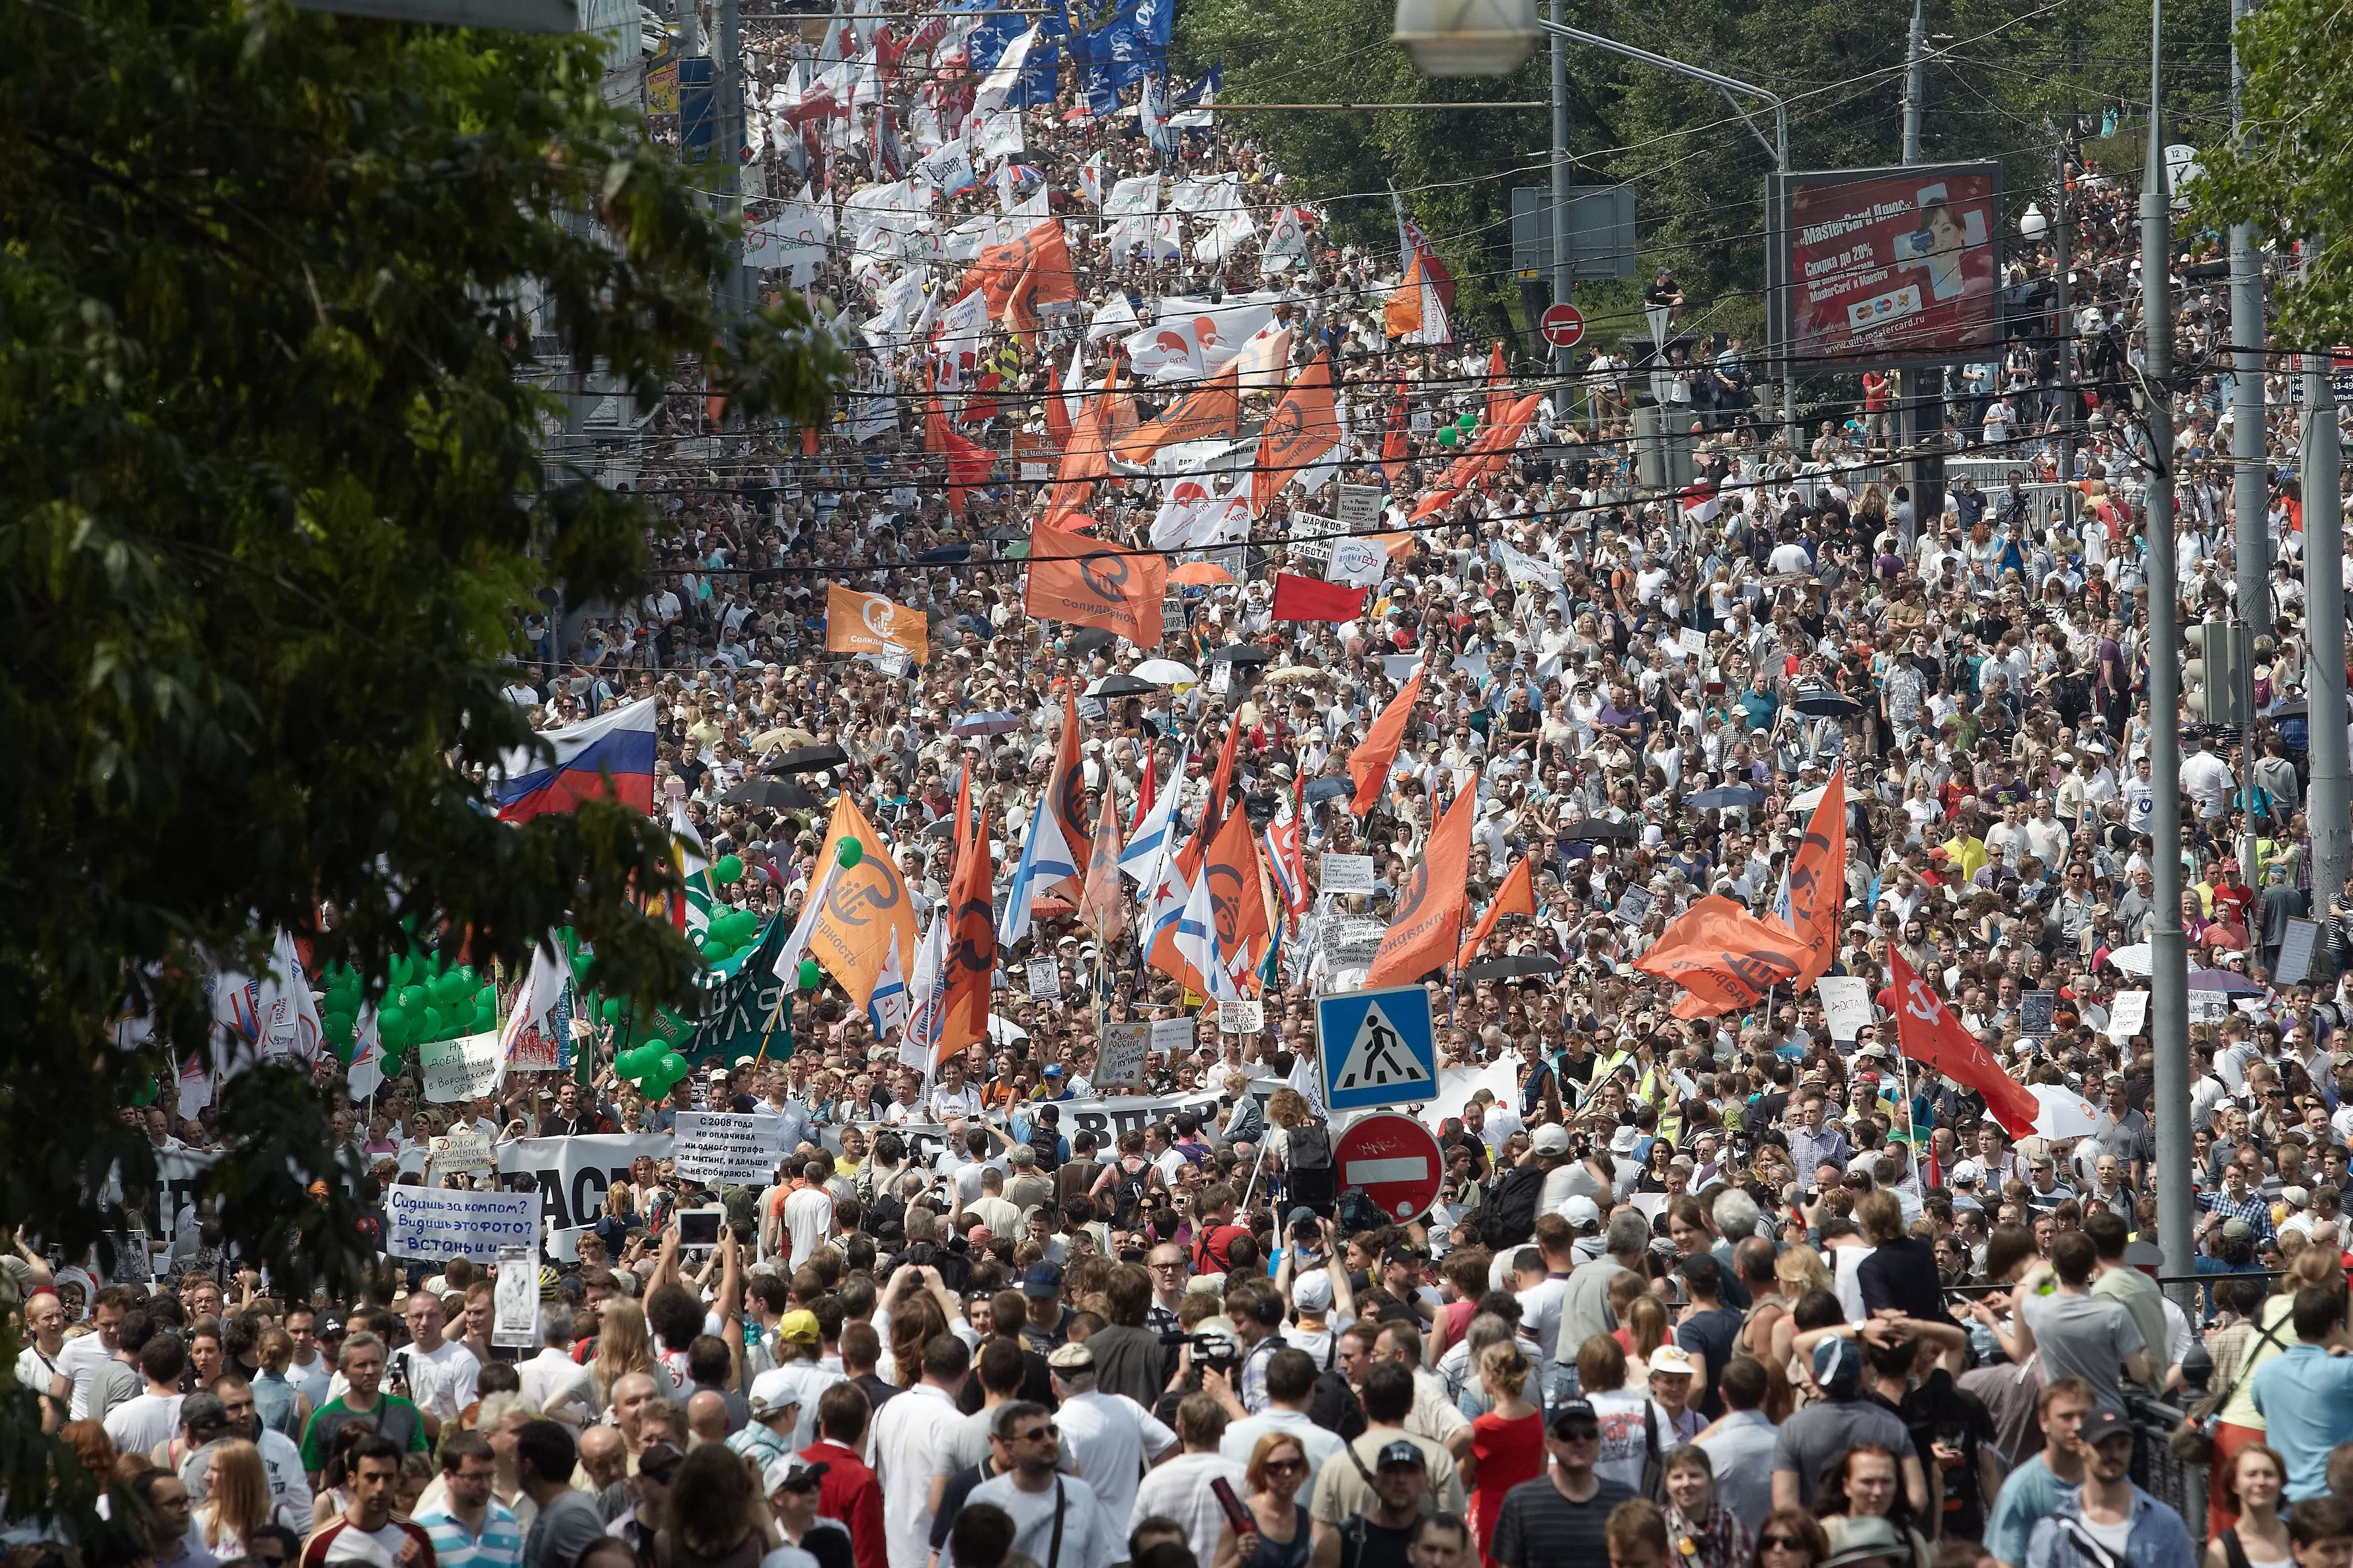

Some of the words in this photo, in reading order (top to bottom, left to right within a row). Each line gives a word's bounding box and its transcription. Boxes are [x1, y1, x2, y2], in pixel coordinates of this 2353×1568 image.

[1804, 255, 1837, 277] Скидка
[1839, 253, 1851, 267] до
[1853, 243, 1873, 261] 20%
[1810, 280, 1851, 303] MasterCard
[1860, 270, 1889, 286] Maestro
[1339, 555, 1361, 563] ПРАВЫХ
[1362, 556, 1378, 567] СИЛ
[817, 917, 856, 966] арность
[1116, 1032, 1136, 1042] ДЕНЬ
[450, 1039, 473, 1051] НЕТ
[709, 1117, 731, 1127] 2008
[733, 1120, 753, 1129] года
[709, 1131, 756, 1141] оплачивал
[432, 1149, 488, 1160] ПРЕЗИДЕНТСКОЕ
[685, 1142, 696, 1150] ни
[698, 1143, 728, 1152] одного
[730, 1145, 765, 1155] штрафа
[680, 1153, 690, 1161] за
[692, 1155, 726, 1166] митинг,
[735, 1157, 769, 1167] дальше
[690, 1167, 701, 1175] не
[703, 1167, 756, 1178] собираюсь!
[392, 1191, 444, 1214] Сидишь
[446, 1202, 463, 1212] за
[465, 1200, 528, 1214] компом?
[398, 1214, 452, 1235] Видишь
